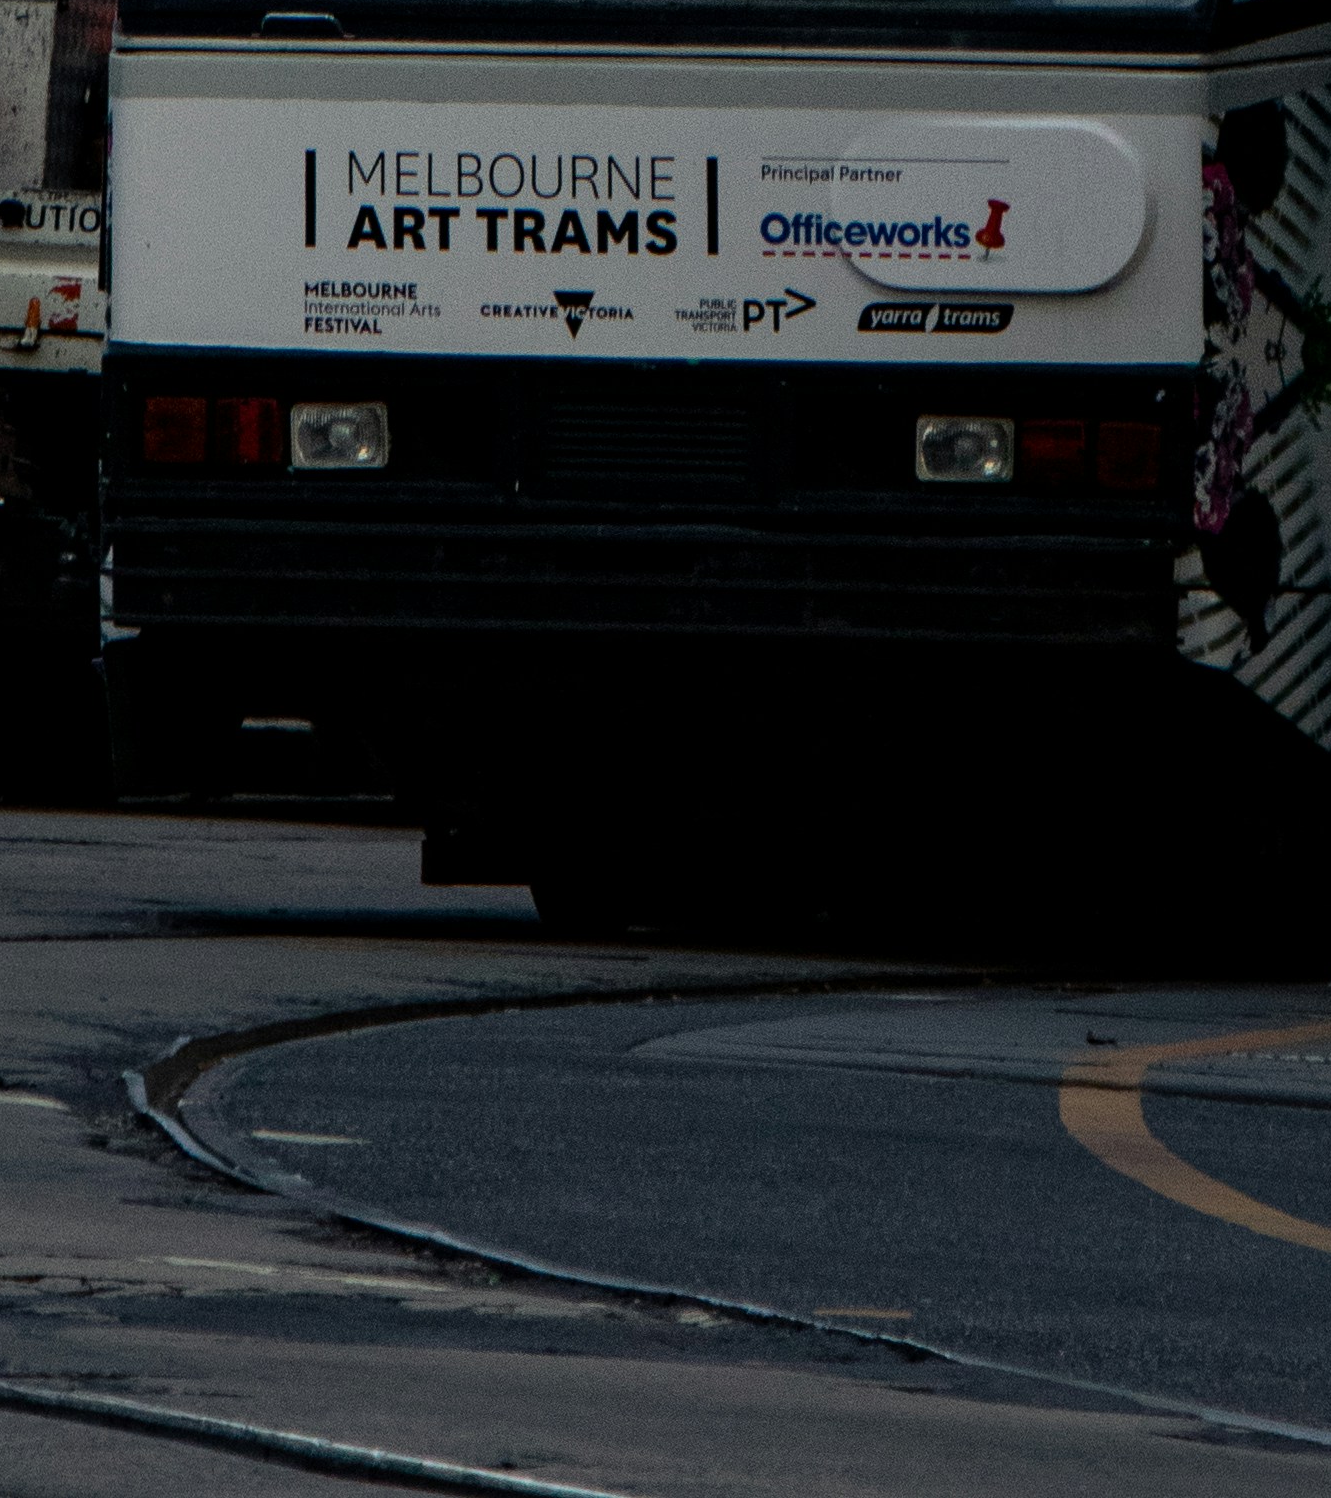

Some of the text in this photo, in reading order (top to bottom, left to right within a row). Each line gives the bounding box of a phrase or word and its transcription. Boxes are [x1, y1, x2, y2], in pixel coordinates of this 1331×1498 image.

[348, 150, 675, 200] MELBOURNE
[761, 164, 904, 185] Principal Partner
[347, 205, 678, 256] ART TRAMS
[760, 213, 971, 248] Officeworks
[304, 281, 418, 300] MELBOURNE
[304, 301, 442, 318] International Arts
[480, 304, 559, 319] CREATIVE
[675, 310, 736, 321] TRANSPORT
[870, 307, 1002, 329] yarra trams
[304, 317, 383, 335] FESTIVAL
[691, 322, 737, 332] VICTORIA
